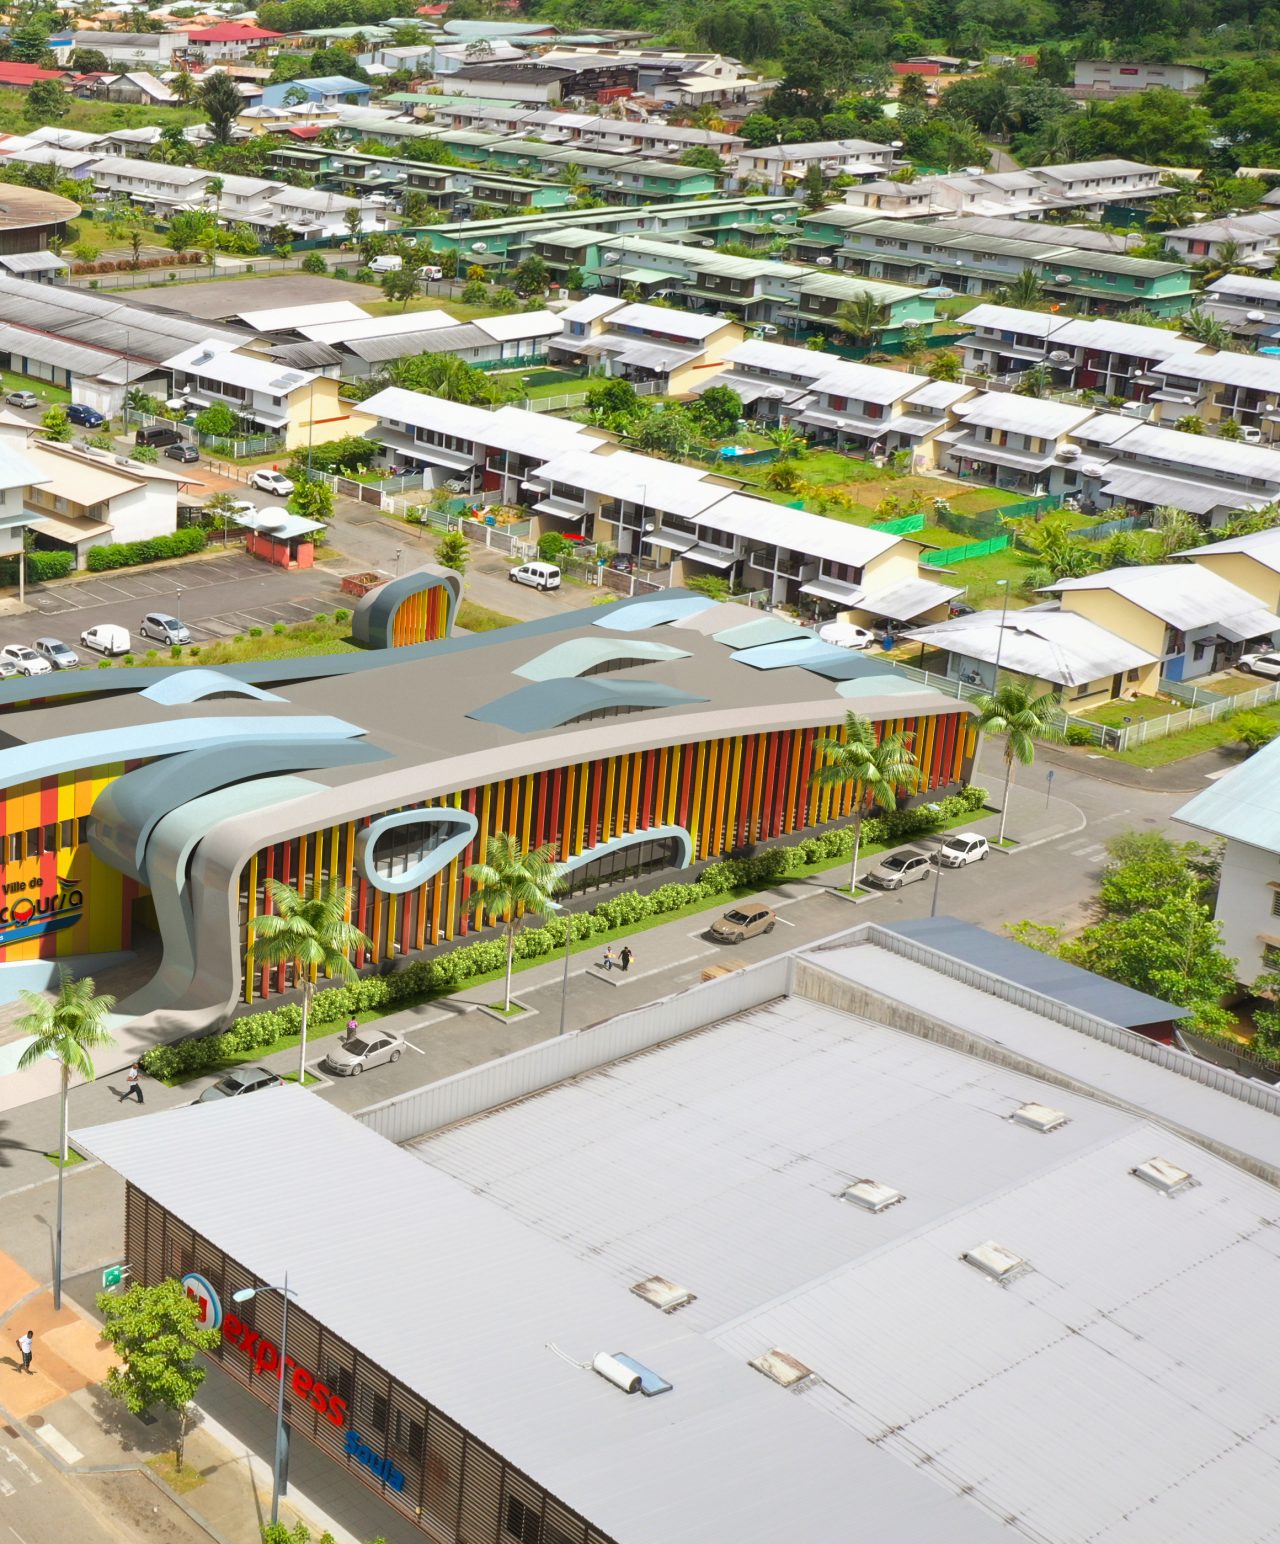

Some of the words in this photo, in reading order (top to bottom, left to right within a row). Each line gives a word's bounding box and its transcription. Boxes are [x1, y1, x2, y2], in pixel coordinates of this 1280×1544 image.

[2, 881, 26, 896] Ville
[28, 877, 44, 890] de
[223, 1313, 347, 1427] express
[343, 1429, 405, 1493] Soula
